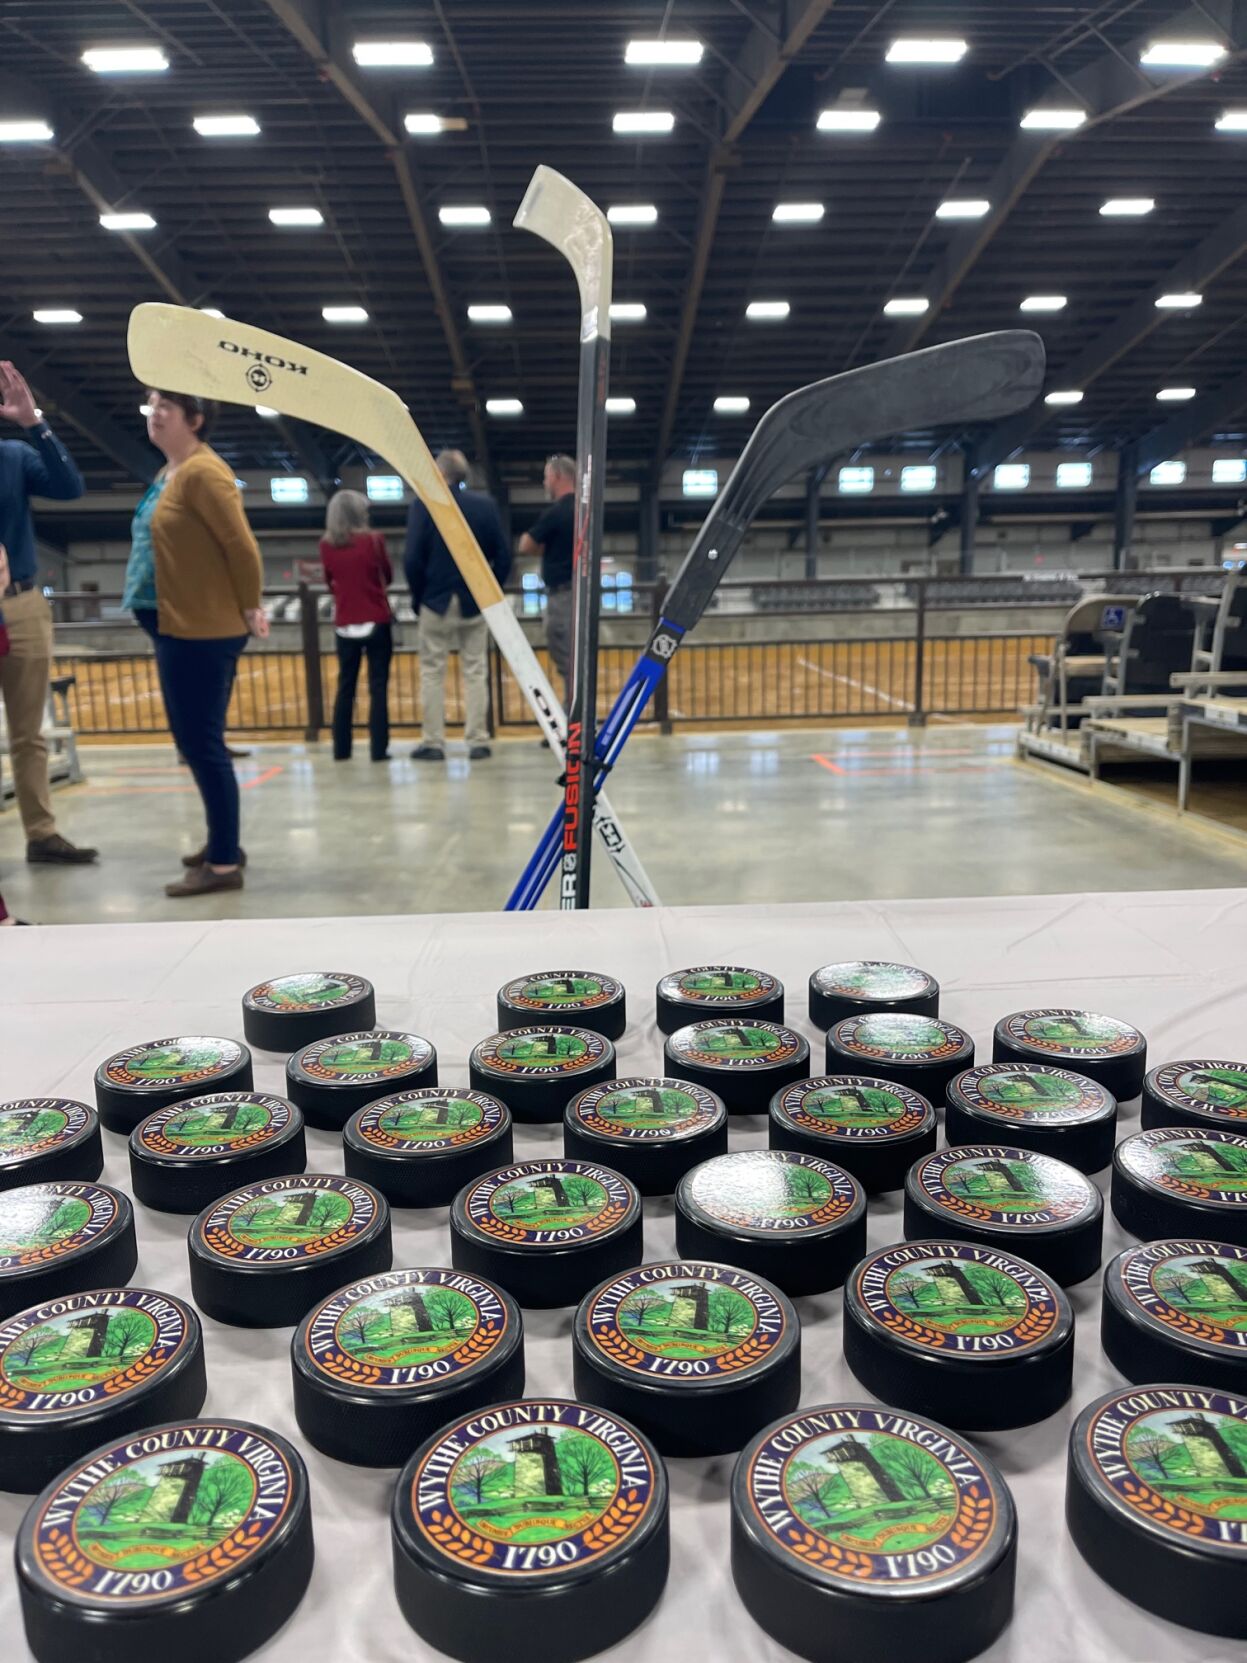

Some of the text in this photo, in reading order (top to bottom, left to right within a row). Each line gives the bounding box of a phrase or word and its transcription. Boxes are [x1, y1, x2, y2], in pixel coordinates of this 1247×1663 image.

[217, 340, 308, 376] KOHO
[563, 722, 581, 852] FUSION
[339, 1072, 378, 1080] 1790
[522, 1066, 559, 1074] 1790
[975, 1064, 1031, 1077] COUNTY
[1193, 1062, 1247, 1072] VIRGI
[399, 1089, 461, 1102] COUNTY
[607, 1079, 666, 1092] COUNTY
[805, 1077, 866, 1090] COUNTY
[0, 1100, 57, 1110] OUNTY
[190, 1094, 255, 1107] COUNTY
[629, 1128, 671, 1138] 1790
[845, 1127, 888, 1136] 1790
[178, 1146, 225, 1155] 1790
[401, 1141, 446, 1149] 1790
[799, 1156, 853, 1195] VIRGINIA
[922, 1160, 947, 1195] WYTHE
[940, 1148, 1009, 1163] COUNTY
[207, 1177, 374, 1228] WYTHE COUNTY VIRGINIA
[469, 1163, 628, 1218] WYTHE COUNTY VIRGINIA
[88, 1190, 114, 1236] VIRGINIA
[760, 1217, 809, 1229] 1790
[1000, 1212, 1050, 1224] 1790
[534, 1227, 583, 1242] 1790
[243, 1247, 299, 1260] 1790
[862, 1245, 1051, 1313] WYTHE COUNTY VIRGINIA
[1126, 1243, 1222, 1306] WYTHE COUNTY
[592, 1265, 781, 1334] WYTHE COUNTY VIRGINIA
[37, 1292, 132, 1320] COUNTY
[135, 1294, 183, 1349] VIRGINIA
[310, 1301, 348, 1355] WYTHE
[346, 1271, 431, 1301] COUNTY
[439, 1273, 503, 1322] VIRGINIA
[956, 1334, 1014, 1351] 1790
[389, 1360, 450, 1384] 1790
[649, 1358, 711, 1375] 1790
[27, 1388, 95, 1410] 1790
[771, 1411, 862, 1452] COUNTY
[1093, 1412, 1130, 1481] WYTHE
[1117, 1391, 1215, 1417] COUNTY
[419, 1405, 648, 1512] WYTHE COUNTY VIRGINIA
[874, 1413, 981, 1487] VIRGINIA
[42, 1428, 287, 1529] WYTHE COUNTY VIRGINIA
[753, 1452, 793, 1533] WYTHE
[502, 1541, 577, 1569] 1790
[884, 1544, 956, 1578] 1790
[94, 1570, 173, 1595] 1790
